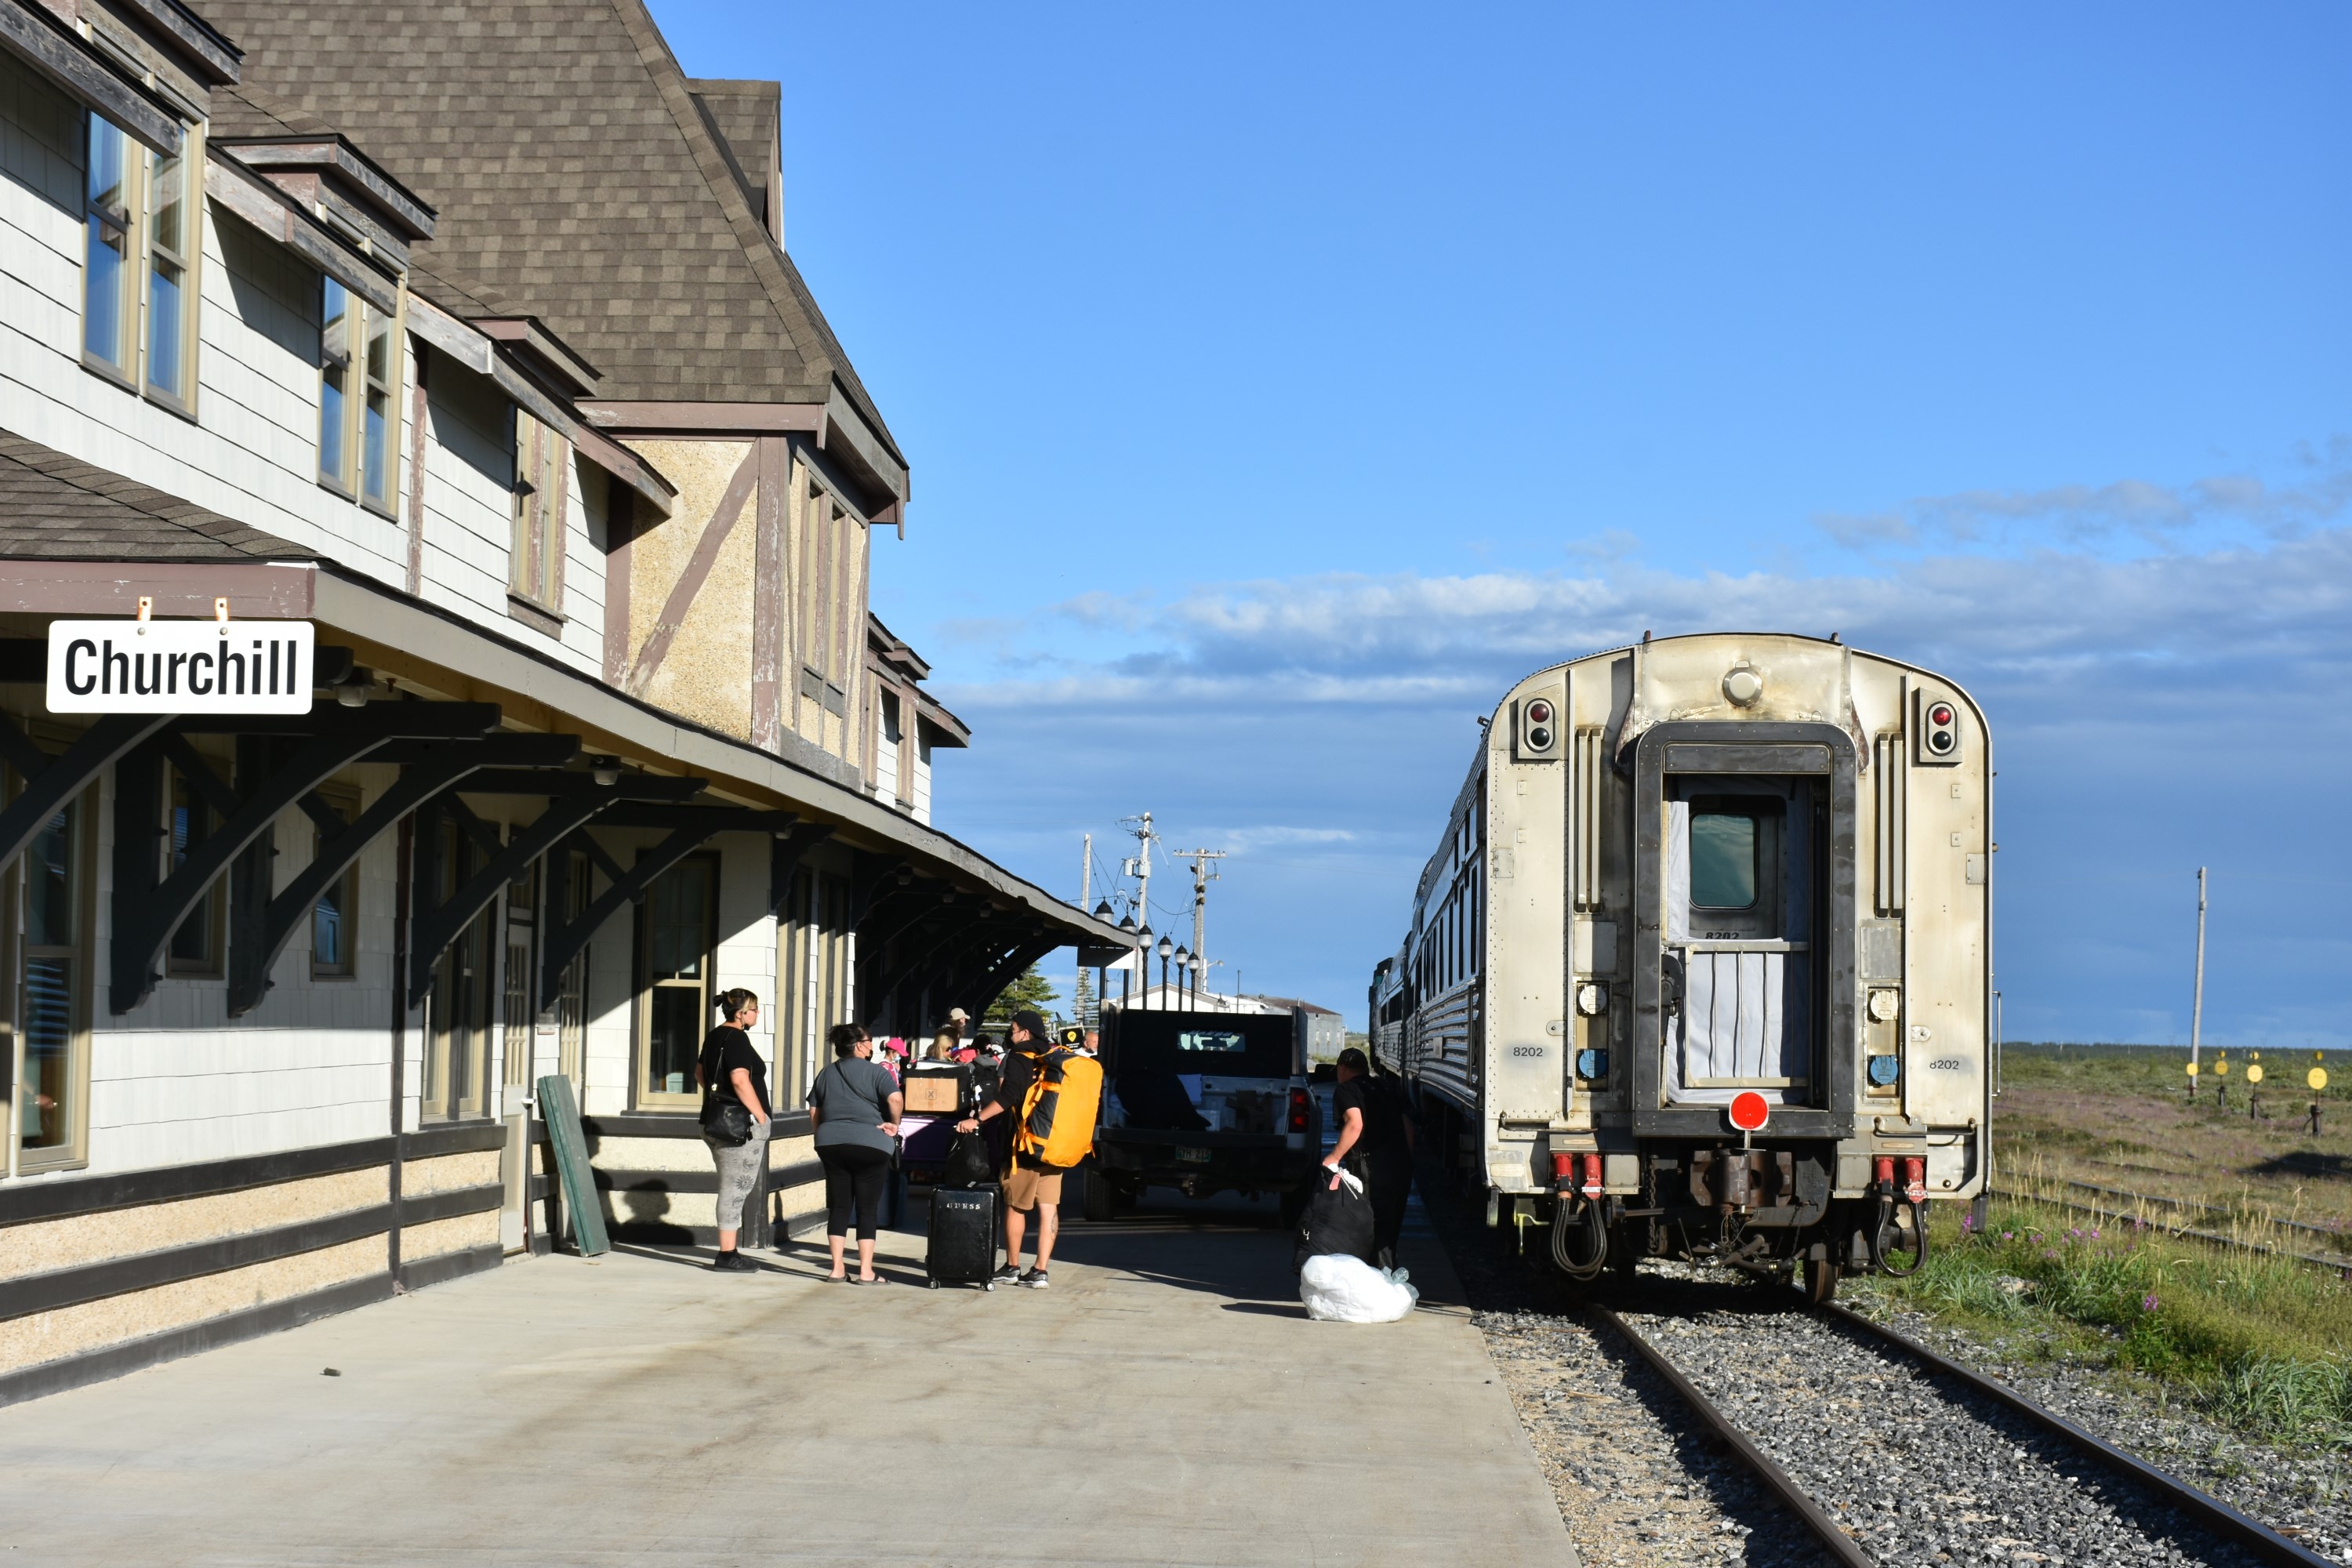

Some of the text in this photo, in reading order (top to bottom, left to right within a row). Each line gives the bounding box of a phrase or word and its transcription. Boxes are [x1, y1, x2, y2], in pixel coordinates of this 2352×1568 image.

[65, 638, 297, 695] Churchill
[1513, 1047, 1543, 1057] 8202
[1929, 1060, 1959, 1069] 8202
